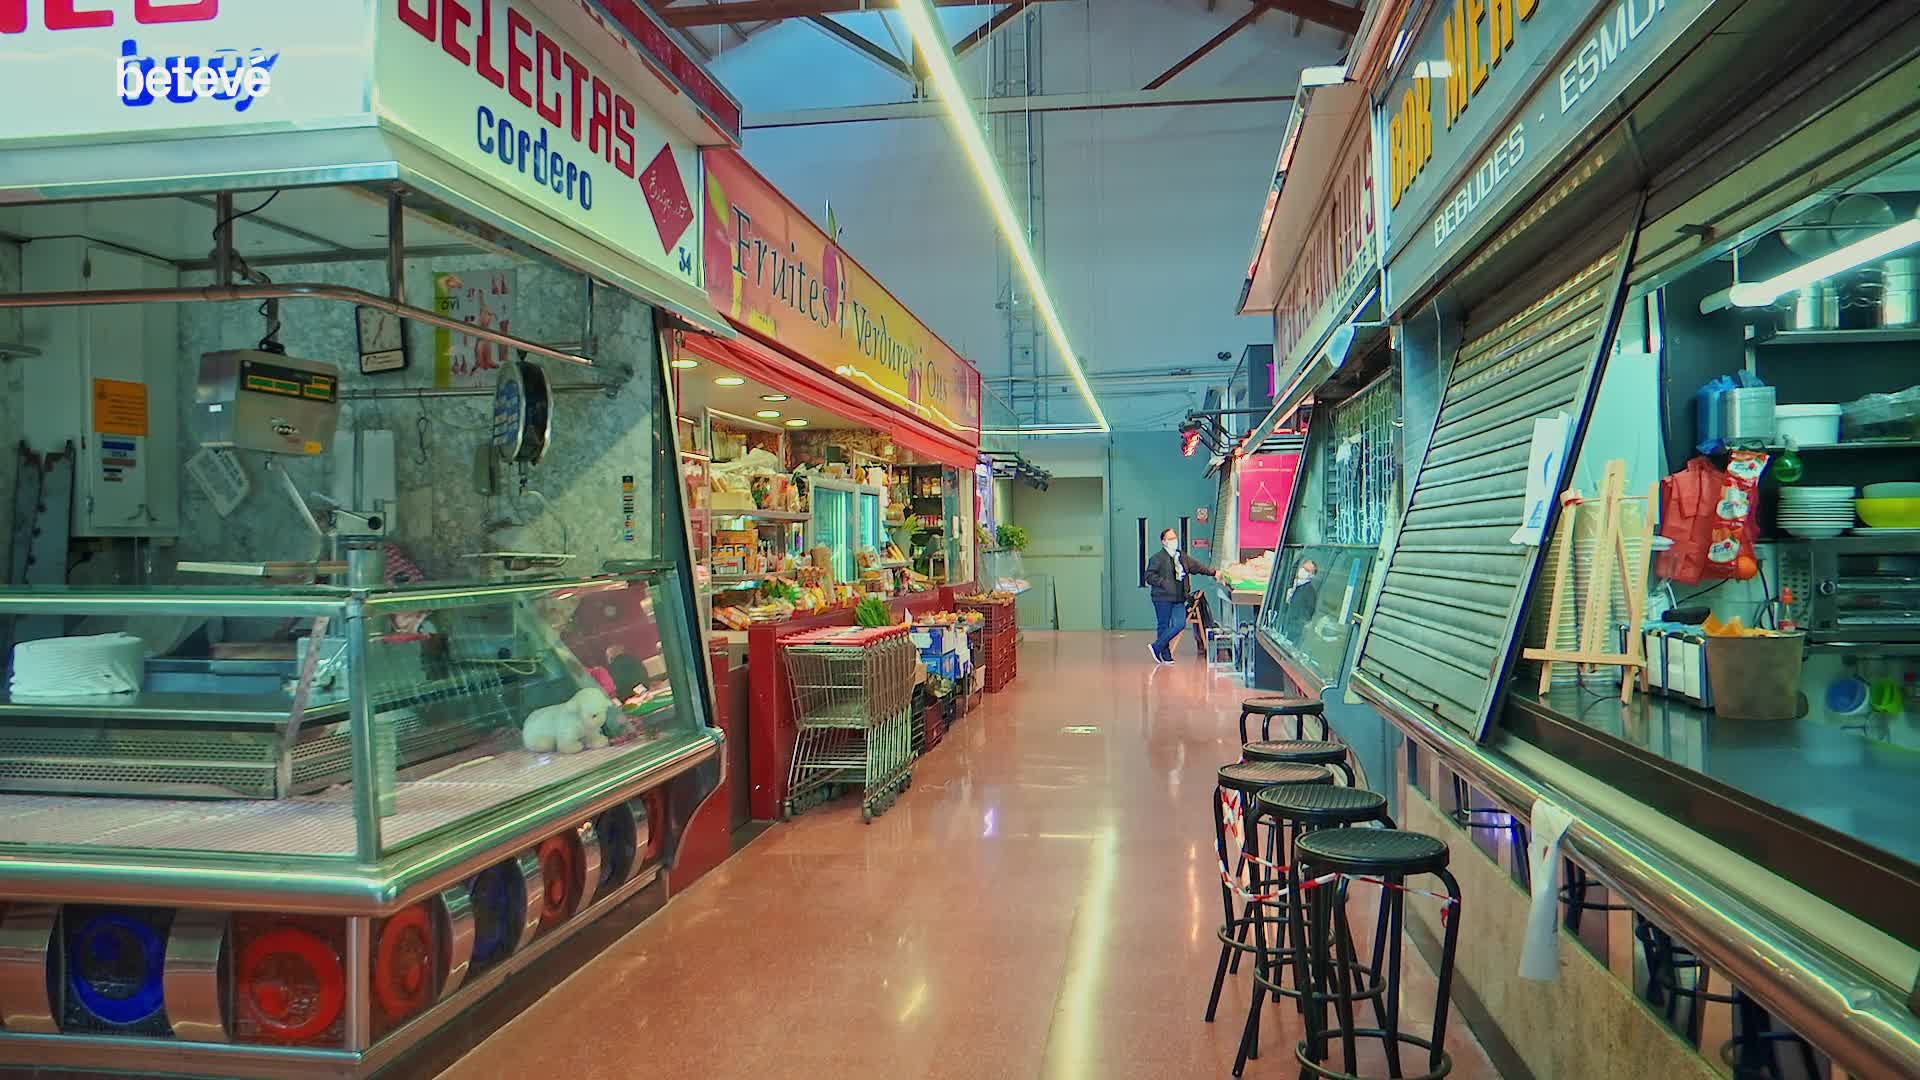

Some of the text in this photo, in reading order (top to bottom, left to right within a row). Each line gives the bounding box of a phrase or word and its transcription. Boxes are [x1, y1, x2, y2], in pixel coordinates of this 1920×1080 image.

[398, 0, 636, 180] ELECTAS
[1390, 75, 1433, 210] BAR
[477, 105, 593, 210] cordero
[1433, 123, 1525, 248] BEGUDES
[678, 246, 692, 276] 34
[731, 204, 830, 329] Fruites
